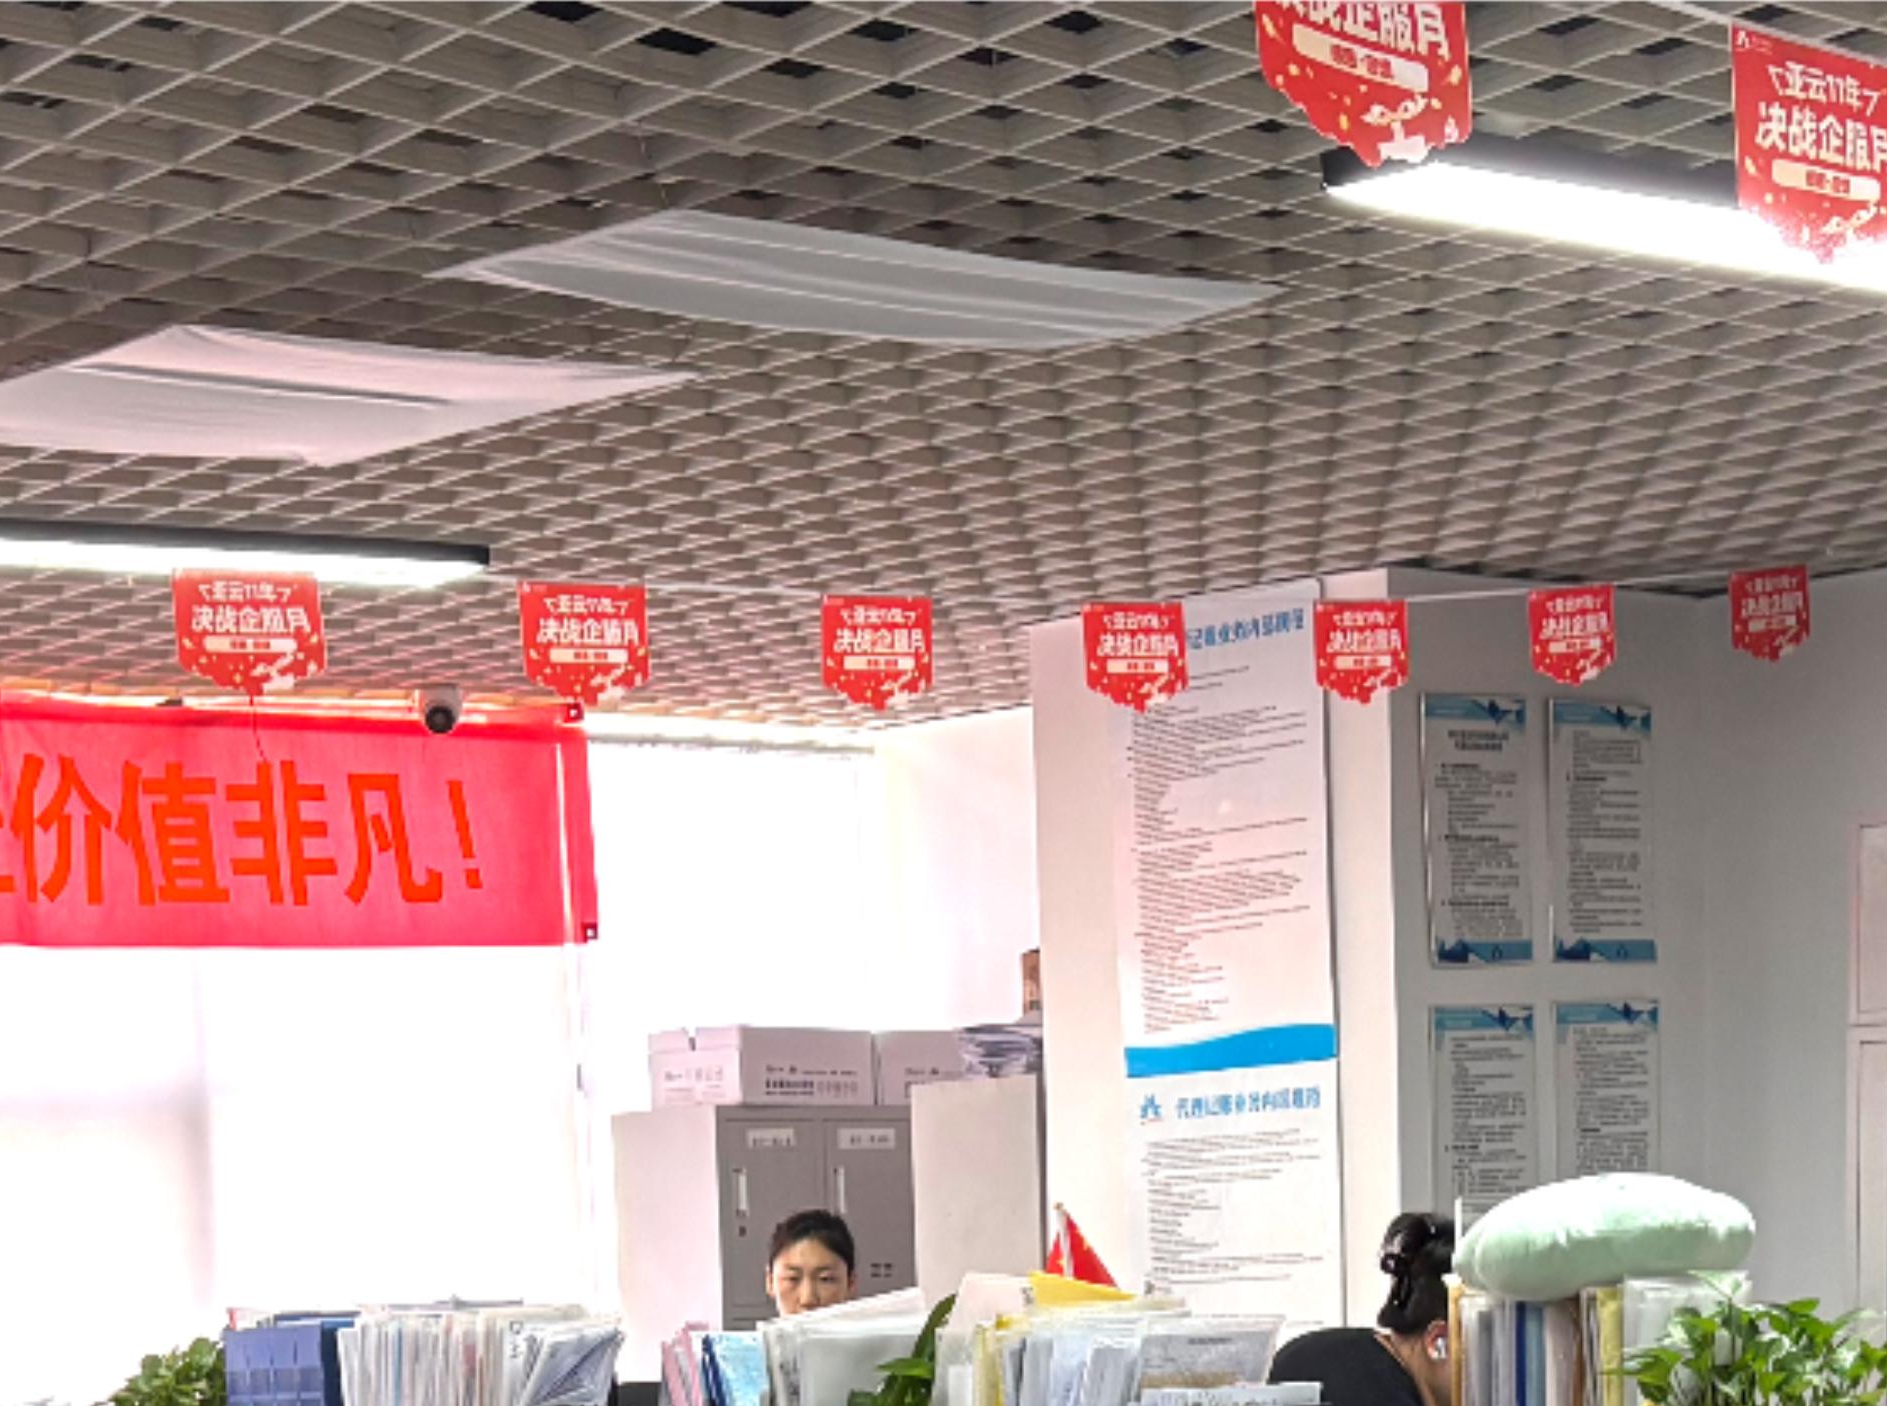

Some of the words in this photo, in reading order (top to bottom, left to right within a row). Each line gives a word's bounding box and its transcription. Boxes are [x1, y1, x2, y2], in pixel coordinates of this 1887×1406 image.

[190, 605, 312, 634] 决战企服月
[537, 617, 641, 646] 决战企服月
